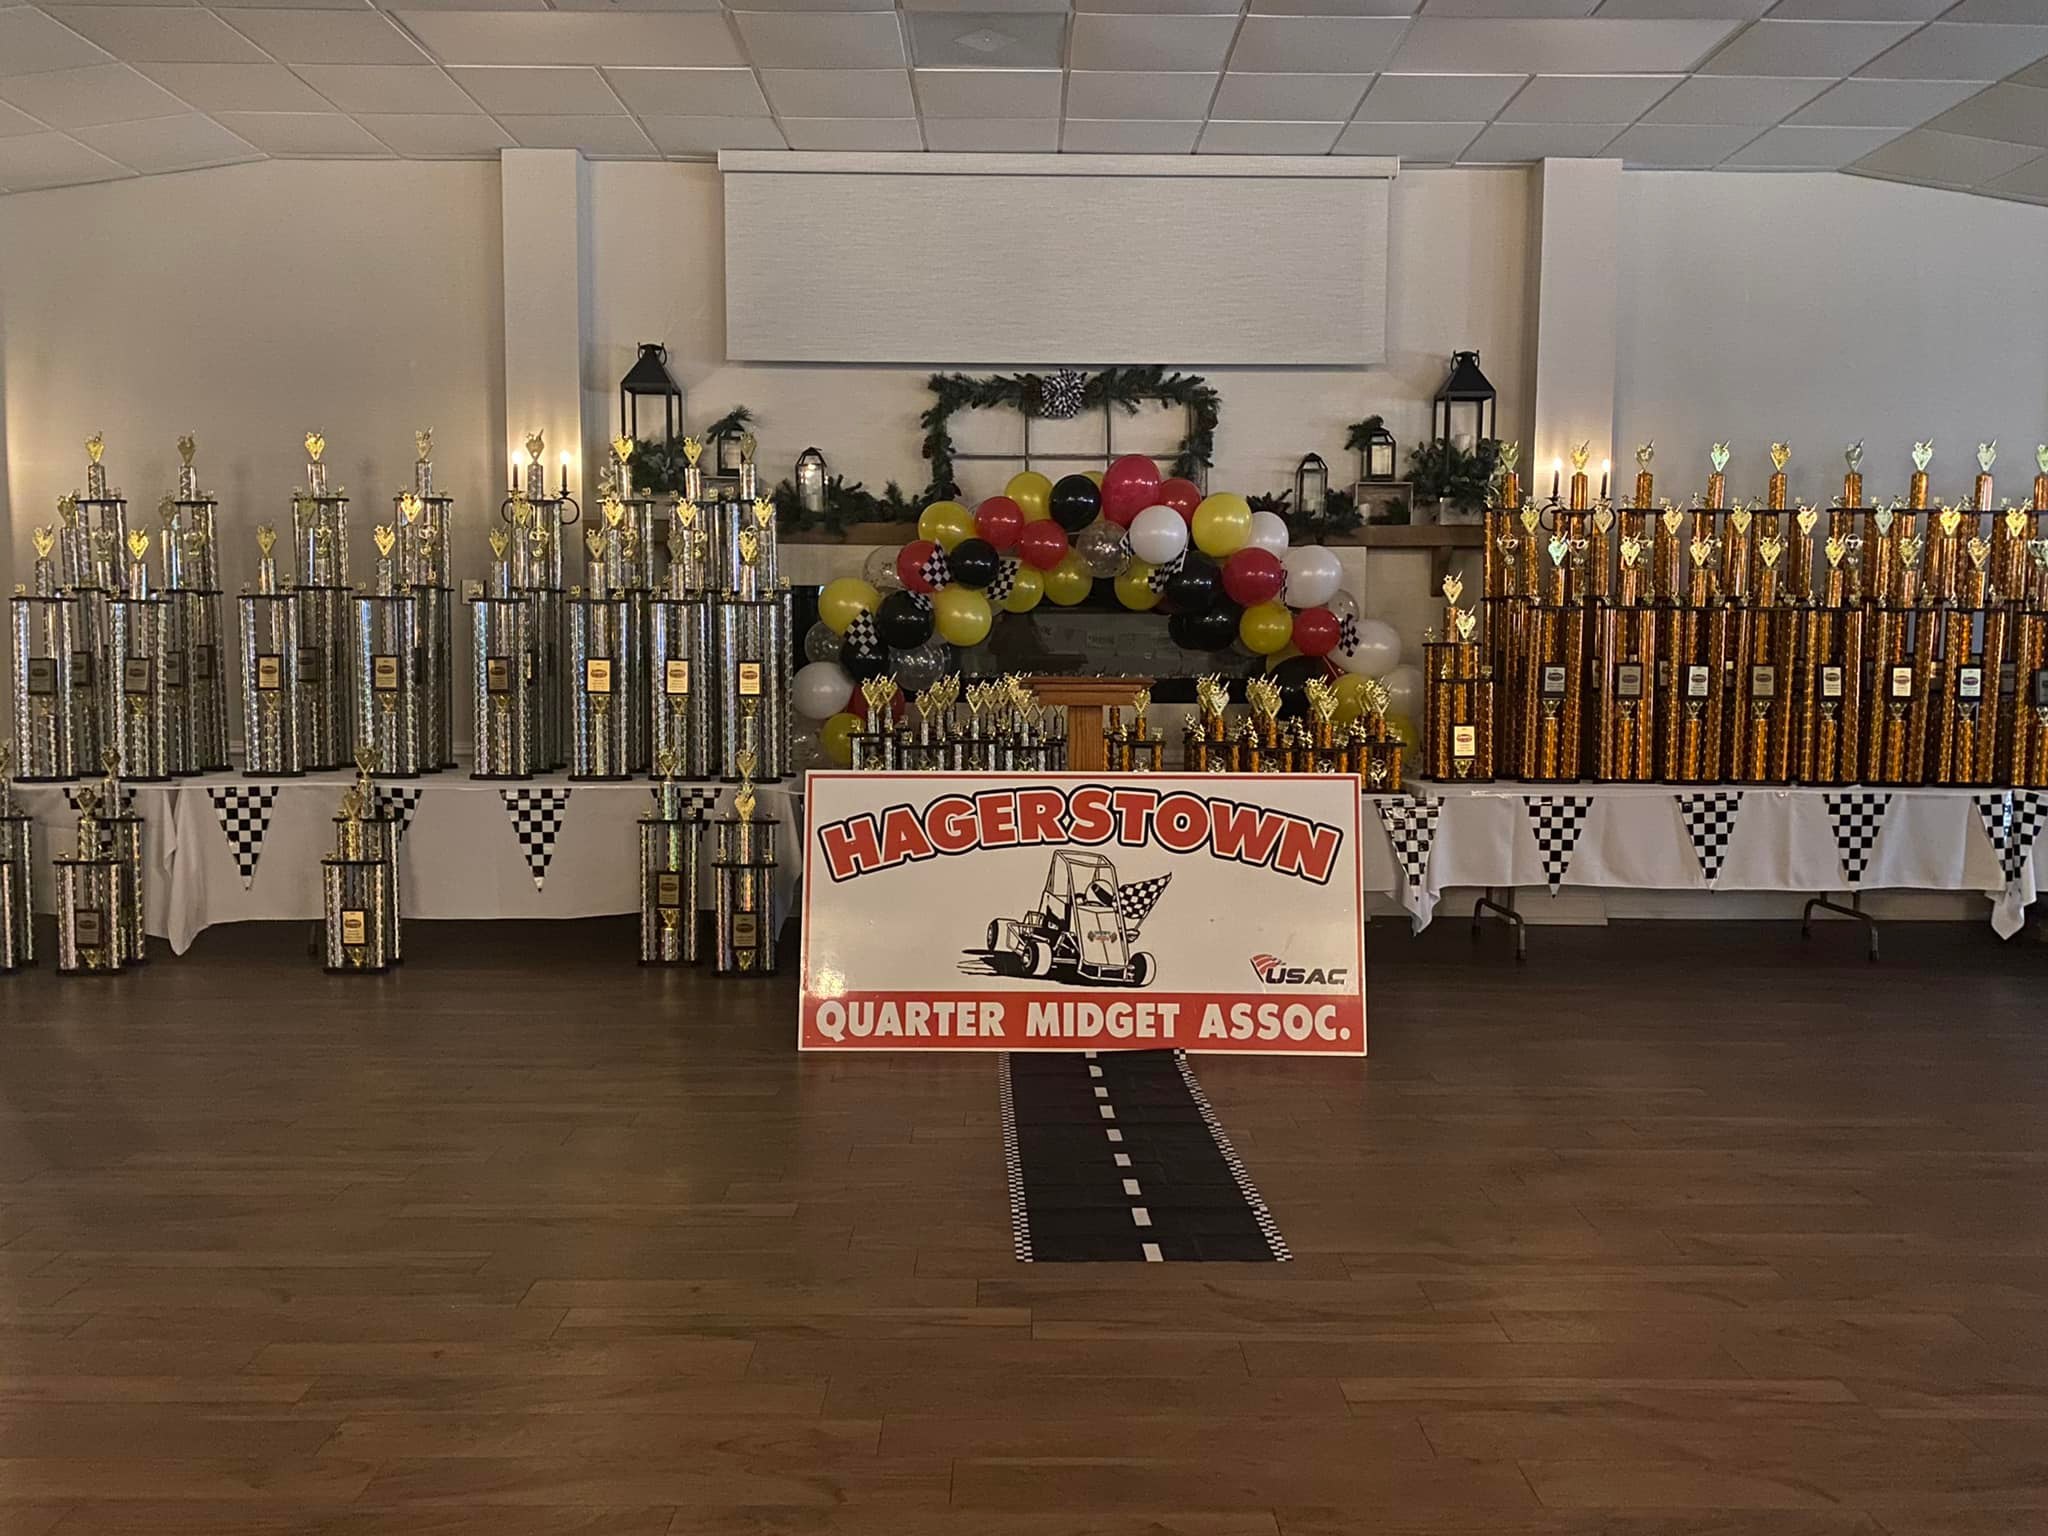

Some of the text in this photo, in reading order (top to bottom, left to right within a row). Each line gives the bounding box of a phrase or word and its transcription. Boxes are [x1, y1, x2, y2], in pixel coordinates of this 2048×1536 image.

[819, 785, 1343, 884] HAGERSTOWN
[1265, 967, 1347, 985] USAC
[816, 1000, 1350, 1042] QUARTER MIDGET ASSOC.
